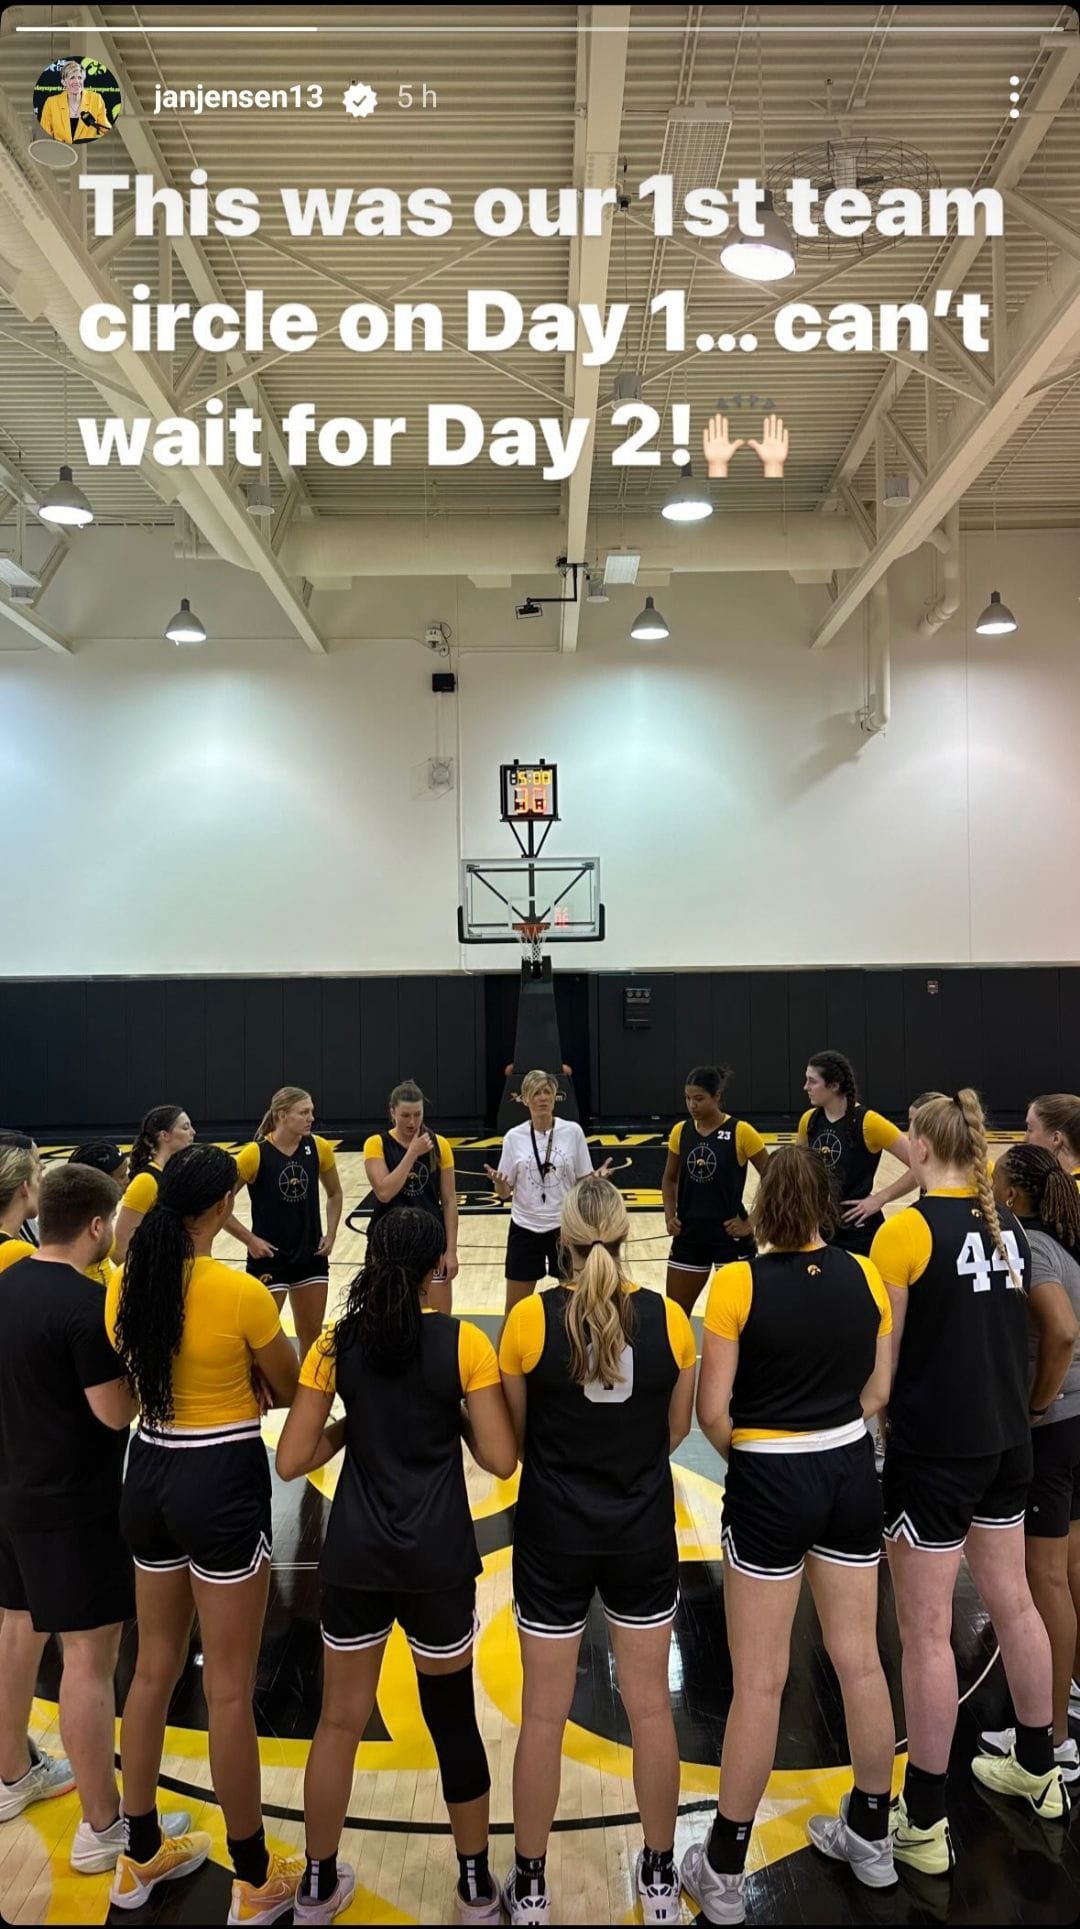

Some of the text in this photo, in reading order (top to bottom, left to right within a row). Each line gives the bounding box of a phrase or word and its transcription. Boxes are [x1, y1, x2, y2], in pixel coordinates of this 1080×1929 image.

[717, 1130, 731, 1140] 23
[304, 1145, 312, 1155] 3
[956, 1230, 1024, 1293] 44
